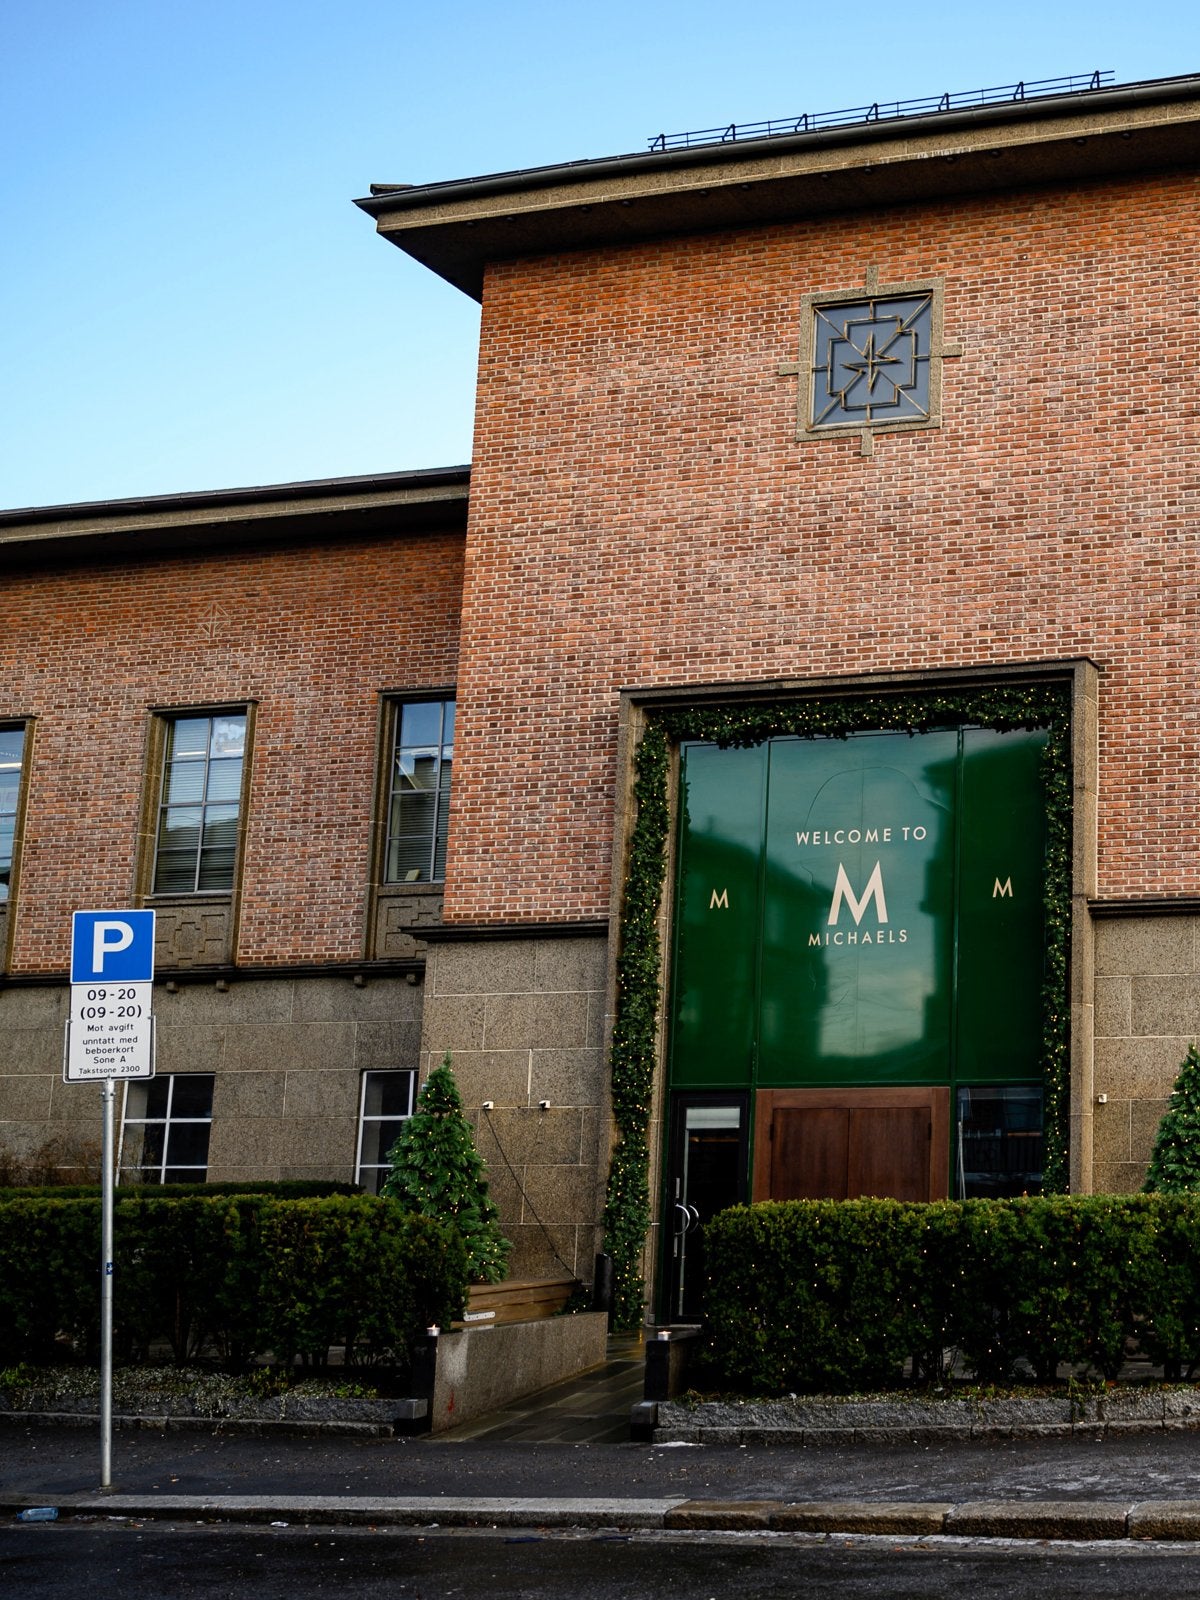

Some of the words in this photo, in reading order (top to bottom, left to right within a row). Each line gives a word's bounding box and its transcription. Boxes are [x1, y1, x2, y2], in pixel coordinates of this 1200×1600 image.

[796, 827, 892, 845] WELCOME
[902, 826, 928, 842] TO
[827, 859, 888, 926] M
[992, 876, 1013, 898] M
[709, 888, 729, 909] M
[808, 929, 908, 946] MICHAELS
[92, 921, 134, 973] P
[87, 1024, 103, 1032] Mot
[108, 1023, 134, 1033] avgift
[82, 1037, 115, 1045] unntatt
[119, 1036, 138, 1044] med
[85, 1046, 134, 1055] beboerkort
[93, 1056, 115, 1064] Sone
[119, 1055, 126, 1063] A
[79, 1067, 117, 1075] Takstsone
[120, 1065, 140, 1073] 2300
